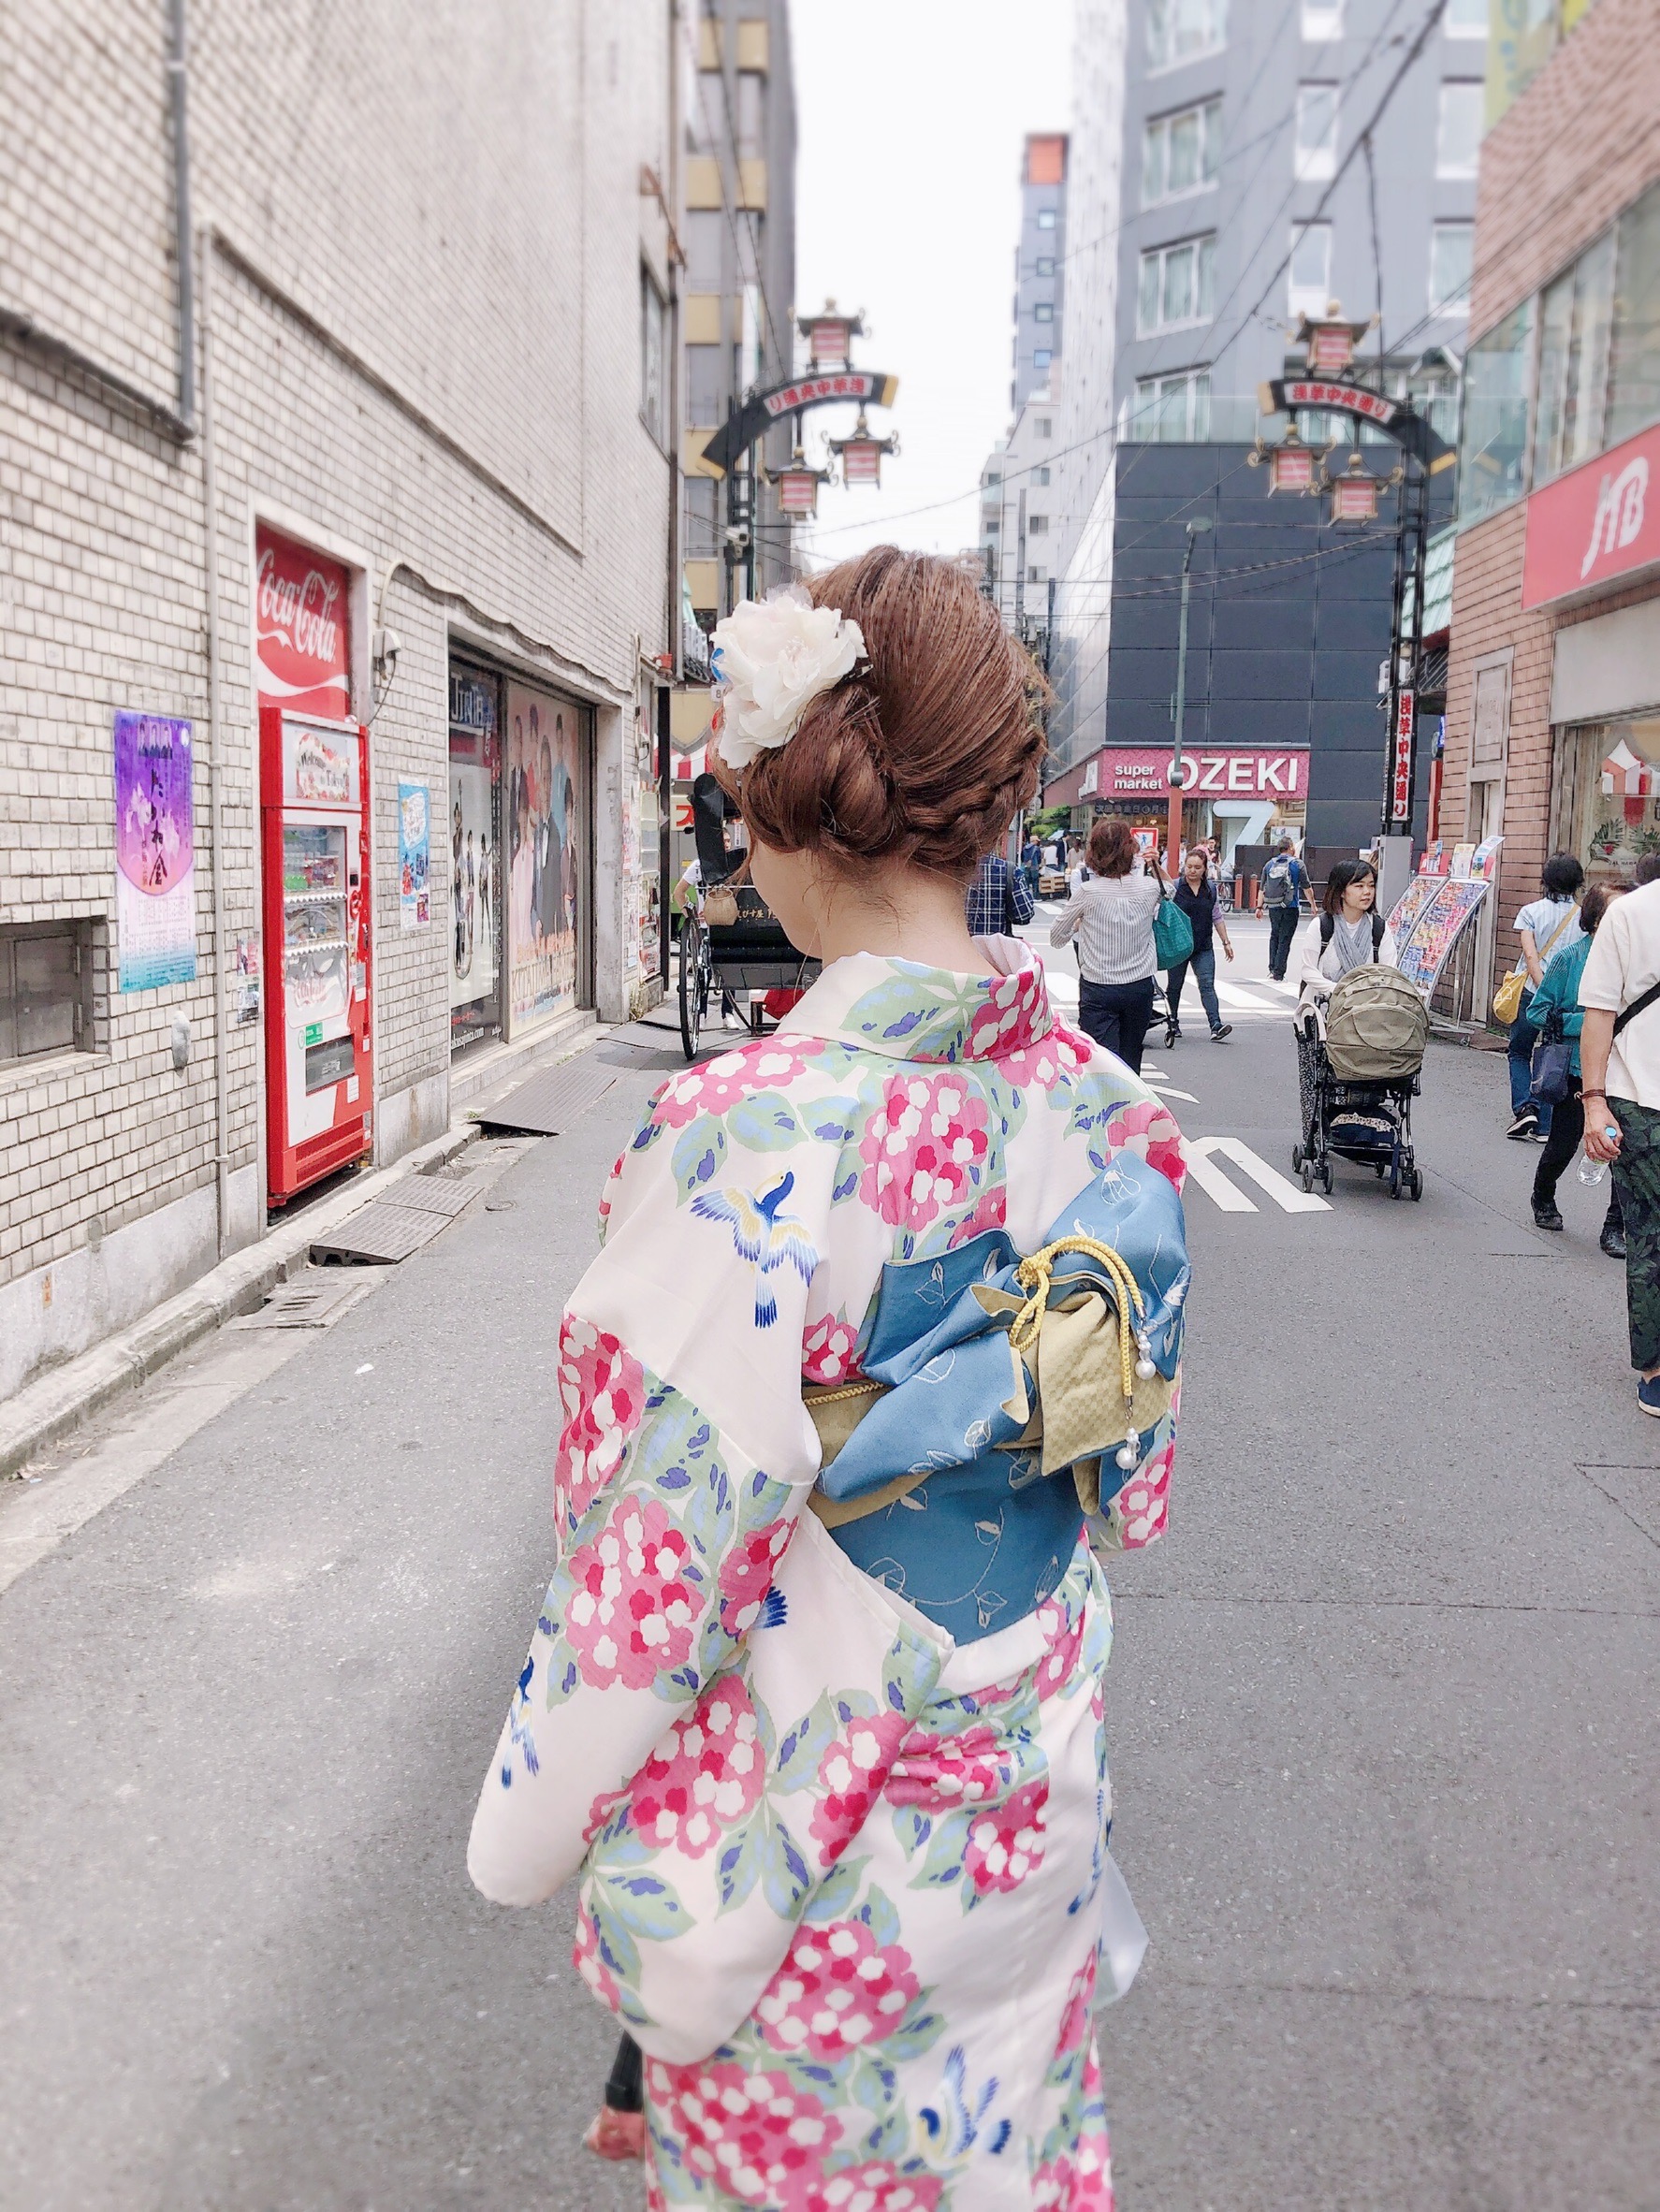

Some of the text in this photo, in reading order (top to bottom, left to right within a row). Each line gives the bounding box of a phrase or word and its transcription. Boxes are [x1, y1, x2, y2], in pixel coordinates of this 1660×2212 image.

[1580, 456, 1651, 580] JTB
[1114, 764, 1156, 778] super
[1167, 756, 1298, 792] OZEKI
[1394, 694, 1413, 819] 浅草中央通り
[1114, 777, 1163, 791] market
